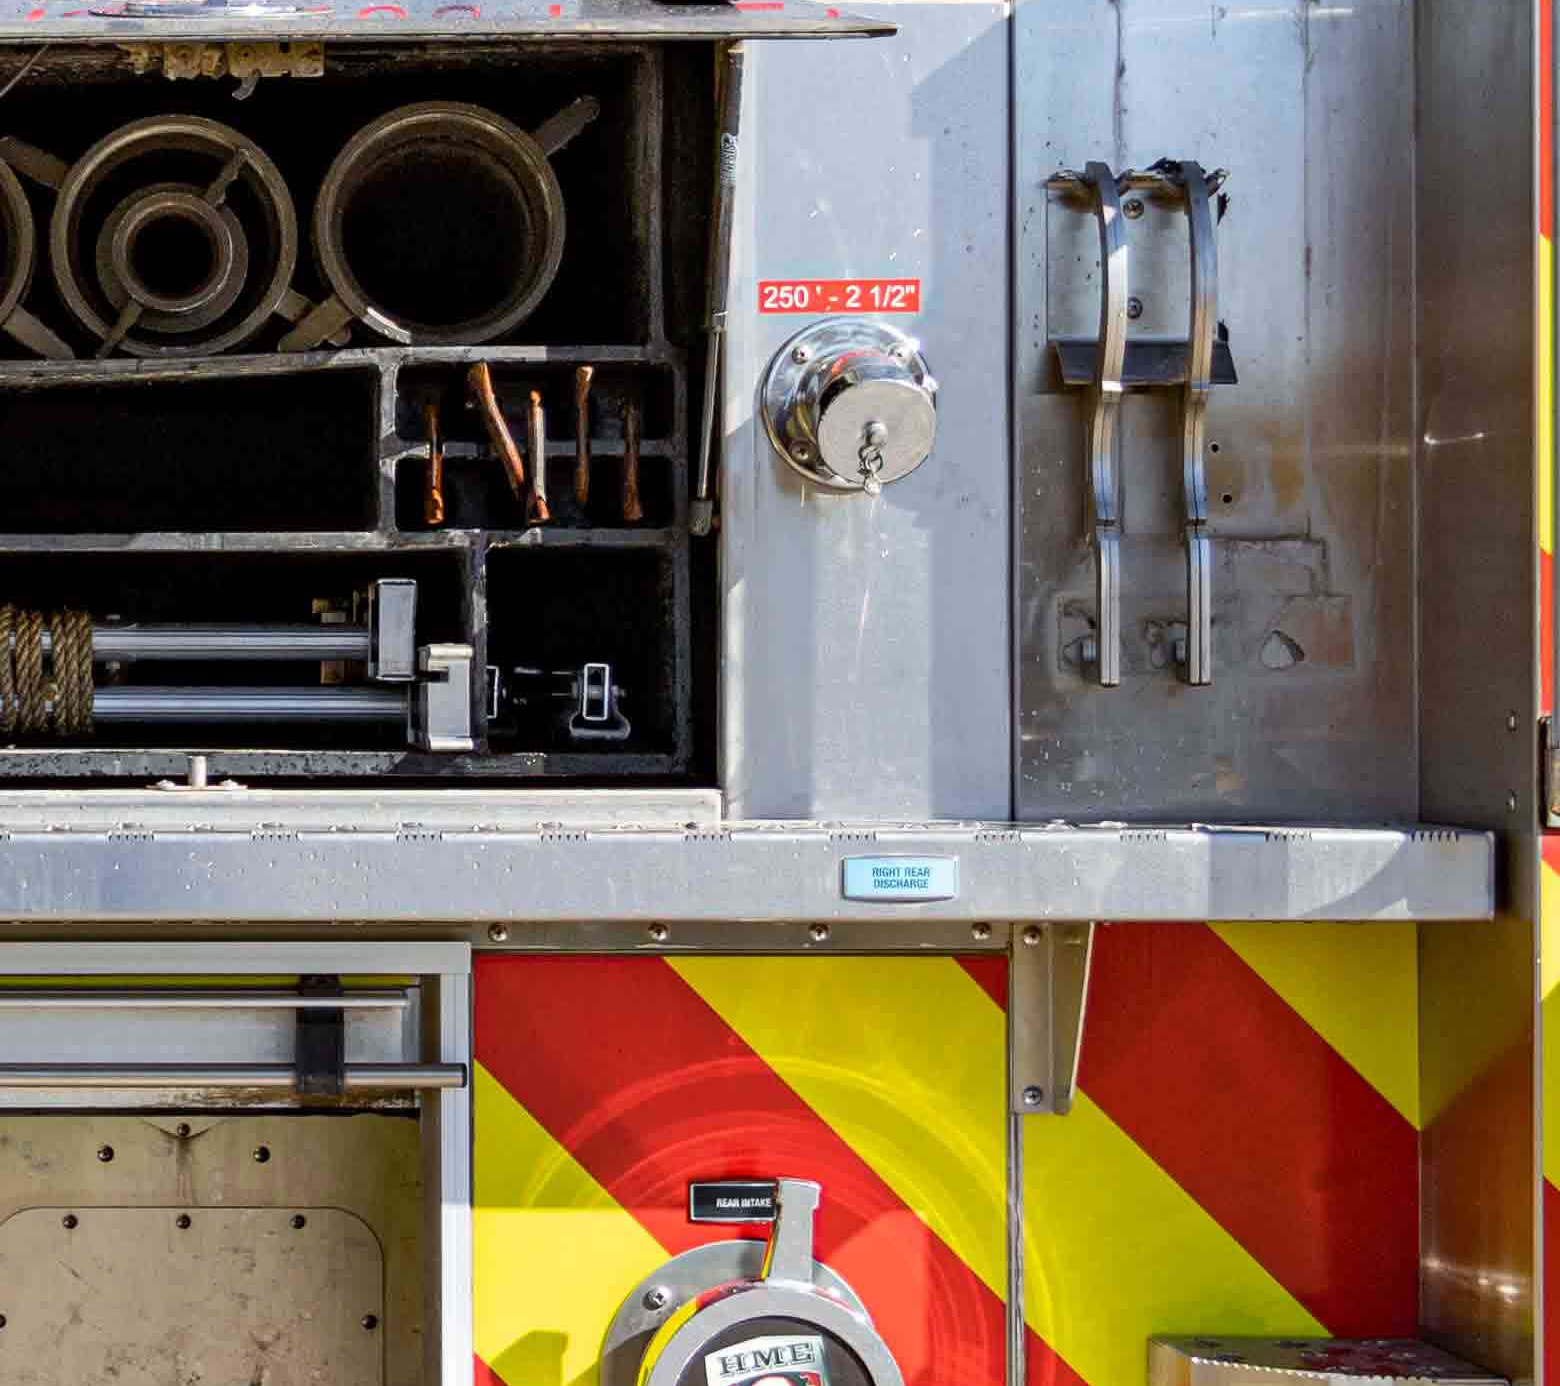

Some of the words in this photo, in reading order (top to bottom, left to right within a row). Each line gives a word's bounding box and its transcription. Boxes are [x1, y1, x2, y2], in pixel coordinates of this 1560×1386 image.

[845, 284, 861, 308] 2
[872, 867, 901, 877] RIGHT
[904, 867, 930, 877] REAR
[873, 878, 929, 889] DISCHARGE
[716, 1198, 740, 1208] REAR
[741, 1198, 772, 1208] INTAKE
[720, 1342, 815, 1376] HME
